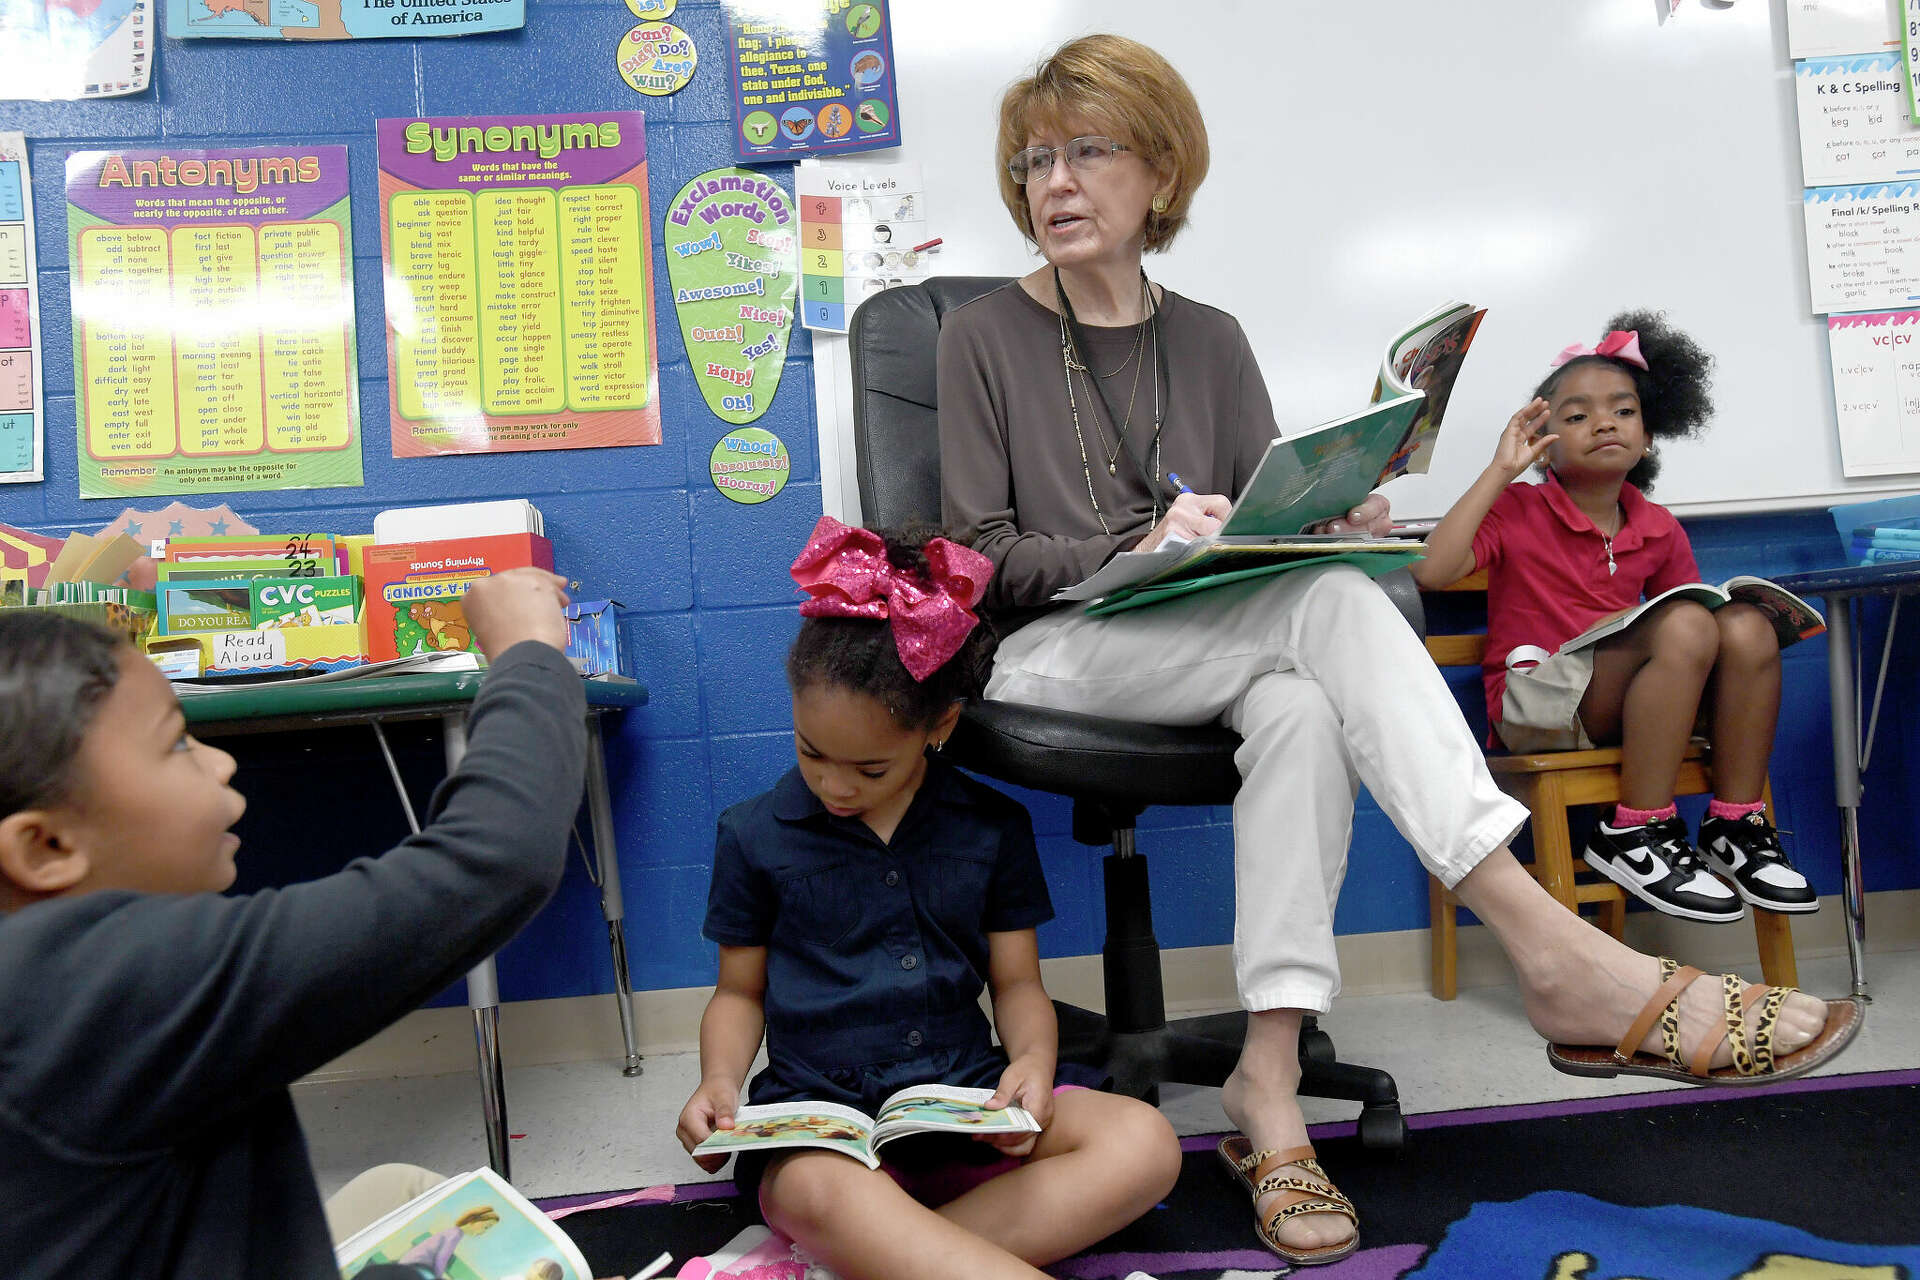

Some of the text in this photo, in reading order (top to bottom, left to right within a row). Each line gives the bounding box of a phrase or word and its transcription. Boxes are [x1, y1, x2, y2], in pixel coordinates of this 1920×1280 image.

[391, 10, 483, 25] of America
[631, 25, 672, 42] Can?
[659, 40, 688, 55] Do?
[738, 37, 762, 50] flag;
[621, 43, 657, 72] Did?
[740, 48, 807, 64] allegiance to
[652, 59, 692, 77] Are?
[741, 62, 828, 77] thee, Texas, one
[633, 74, 676, 90] Will?
[742, 74, 827, 91] state under God,
[1817, 81, 1900, 94] K & C Spelling
[743, 95, 763, 105] one
[766, 91, 786, 104] and
[1832, 114, 1883, 128] keg kid
[405, 120, 621, 162] Synonyms
[472, 161, 558, 172] Words that have the
[98, 155, 321, 194] Antonyms
[458, 172, 572, 183] same or similar meanings.
[828, 177, 897, 191] Voice Levels
[136, 196, 287, 209] Words that mean the opposite, or
[562, 193, 616, 205] respect honor
[670, 176, 791, 227] Exclamation
[133, 209, 164, 220] nearly
[166, 208, 181, 218] the
[227, 207, 237, 217] of
[239, 206, 260, 216] each
[263, 206, 289, 216] other.
[418, 208, 468, 219] ask question
[568, 203, 623, 213] revise correct
[698, 202, 766, 225] Words
[816, 201, 827, 215] 4
[1831, 204, 1910, 217] Final /k/ Spelling
[397, 219, 461, 230] beginner novice
[96, 233, 152, 243] above below
[496, 227, 545, 238] kind helpful
[817, 229, 826, 241] 3
[674, 231, 722, 258] Wow!
[727, 252, 782, 278] Yikes!
[818, 255, 827, 268] 2
[678, 278, 764, 302] Awesome!
[819, 280, 828, 295] 1
[487, 302, 541, 311] mistake error
[571, 297, 631, 308] terrify frighten
[740, 305, 785, 326] Nice!
[692, 325, 744, 343] Ouch!
[742, 334, 780, 359] Yes!
[95, 376, 152, 385] difficult easy
[707, 363, 753, 386] Help!
[579, 382, 645, 392] word expression
[270, 390, 344, 400] vertical horizontal
[108, 398, 129, 408] early
[722, 394, 753, 412] Oh!
[513, 425, 529, 433] may
[562, 422, 579, 431] only
[500, 432, 531, 441] meaning
[723, 437, 778, 457] Whoa!
[164, 468, 175, 476] An
[177, 467, 209, 477] antonym
[211, 467, 226, 475] may
[253, 463, 285, 473] opposite
[286, 462, 297, 470] for
[712, 455, 788, 473] Absolutely!
[101, 466, 157, 478] Remember
[179, 476, 195, 485] only
[213, 474, 245, 484] meaning
[246, 473, 256, 481] of
[718, 475, 776, 495] Hooray!
[284, 540, 312, 560] 24
[288, 560, 316, 578] 23
[410, 556, 485, 571] Rhyming Sounds
[260, 584, 351, 606] CVC PUZZLES
[178, 616, 250, 628] DO YOU REA
[225, 632, 266, 647] Read
[220, 644, 273, 664] Aloud
